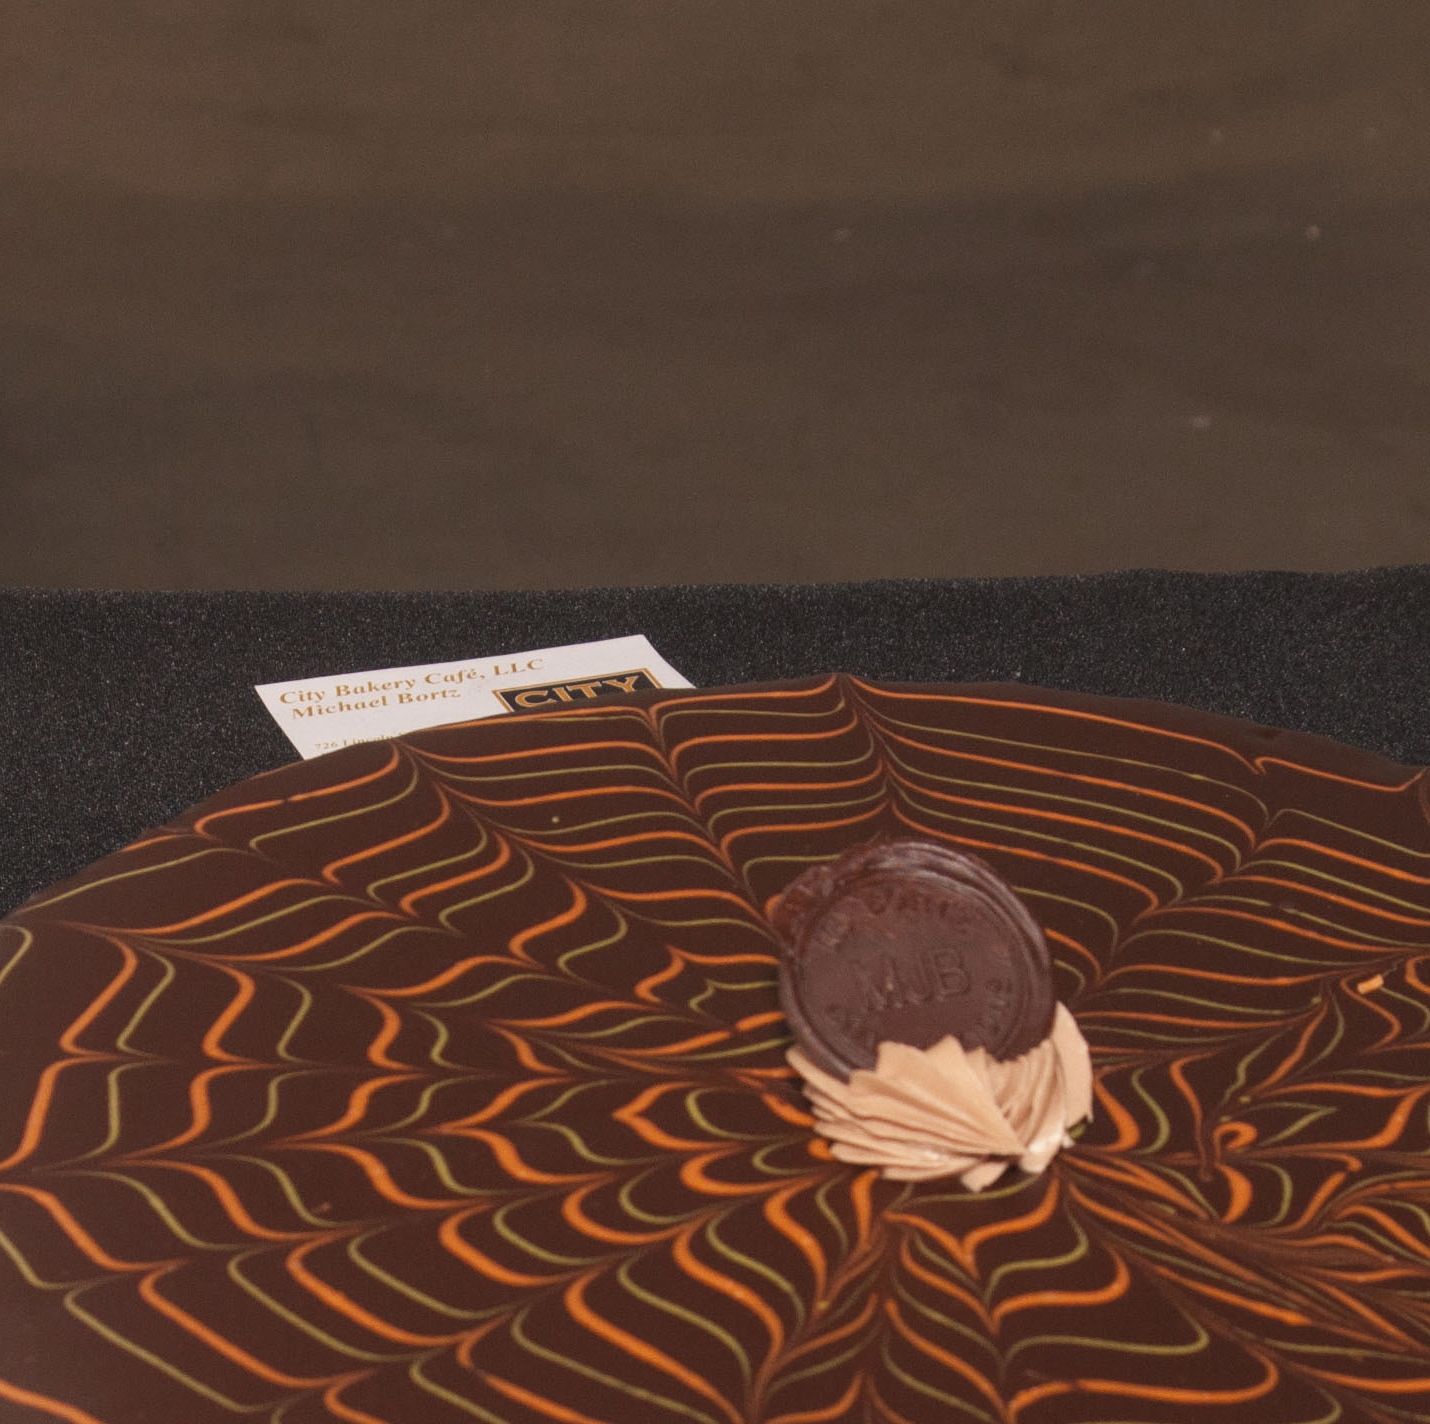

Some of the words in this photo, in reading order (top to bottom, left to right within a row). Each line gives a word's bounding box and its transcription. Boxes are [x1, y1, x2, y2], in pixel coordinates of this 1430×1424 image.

[279, 690, 325, 705] City
[335, 677, 416, 698] Bakery
[424, 667, 486, 685] Café,
[493, 658, 543, 676] LLC
[514, 675, 639, 708] CITY
[292, 696, 387, 719] Michael
[398, 687, 461, 705] Bortz
